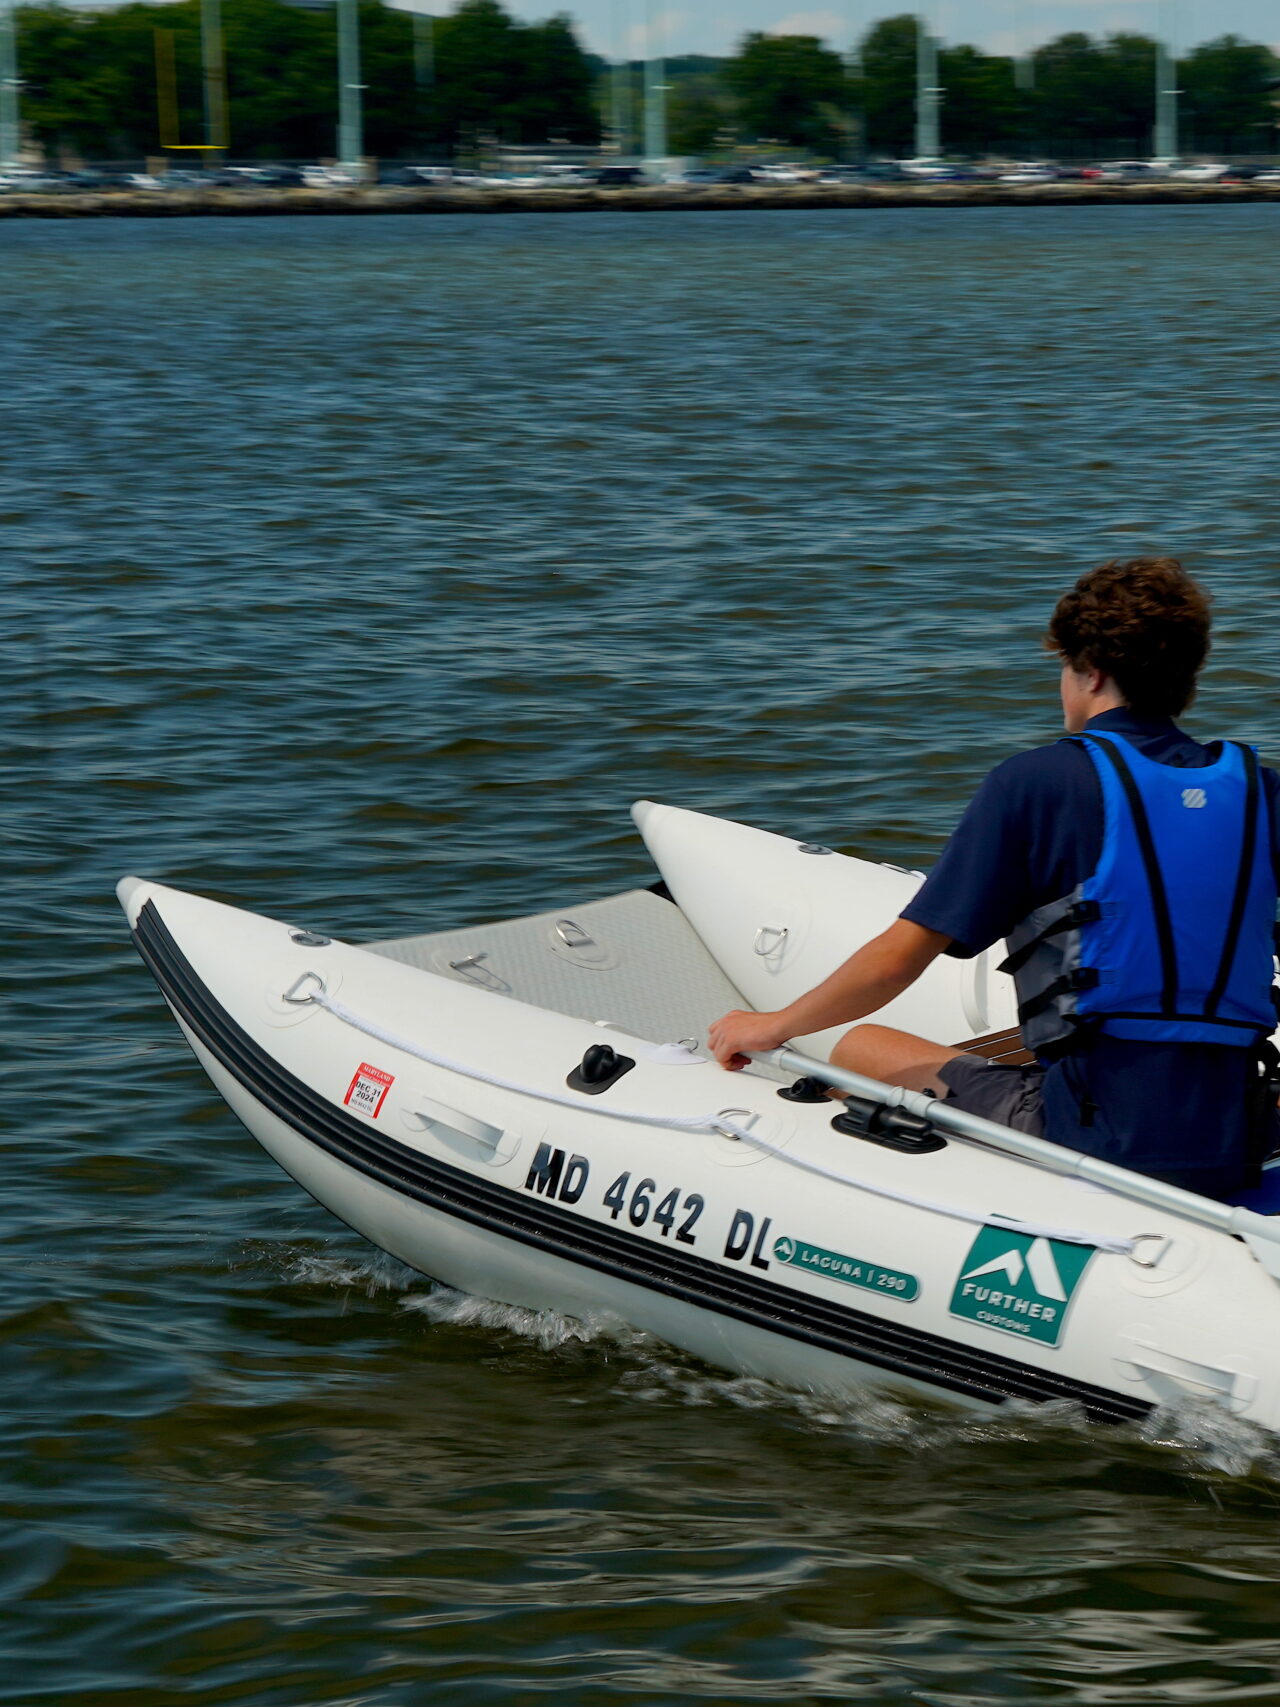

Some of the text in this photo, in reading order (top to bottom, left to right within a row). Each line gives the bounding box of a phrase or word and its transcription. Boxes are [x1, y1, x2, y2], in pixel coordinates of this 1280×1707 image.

[364, 1065, 390, 1081] MARYLAND
[355, 1081, 371, 1092] DEC
[371, 1088, 382, 1098] 31
[356, 1090, 374, 1103] 2024
[524, 1142, 773, 1272] MD 4642 DL
[801, 1250, 862, 1279] LAGUNA
[877, 1273, 907, 1291] 290
[961, 1282, 1057, 1323] FURTHER
[976, 1310, 1032, 1334] CUSTOMS
